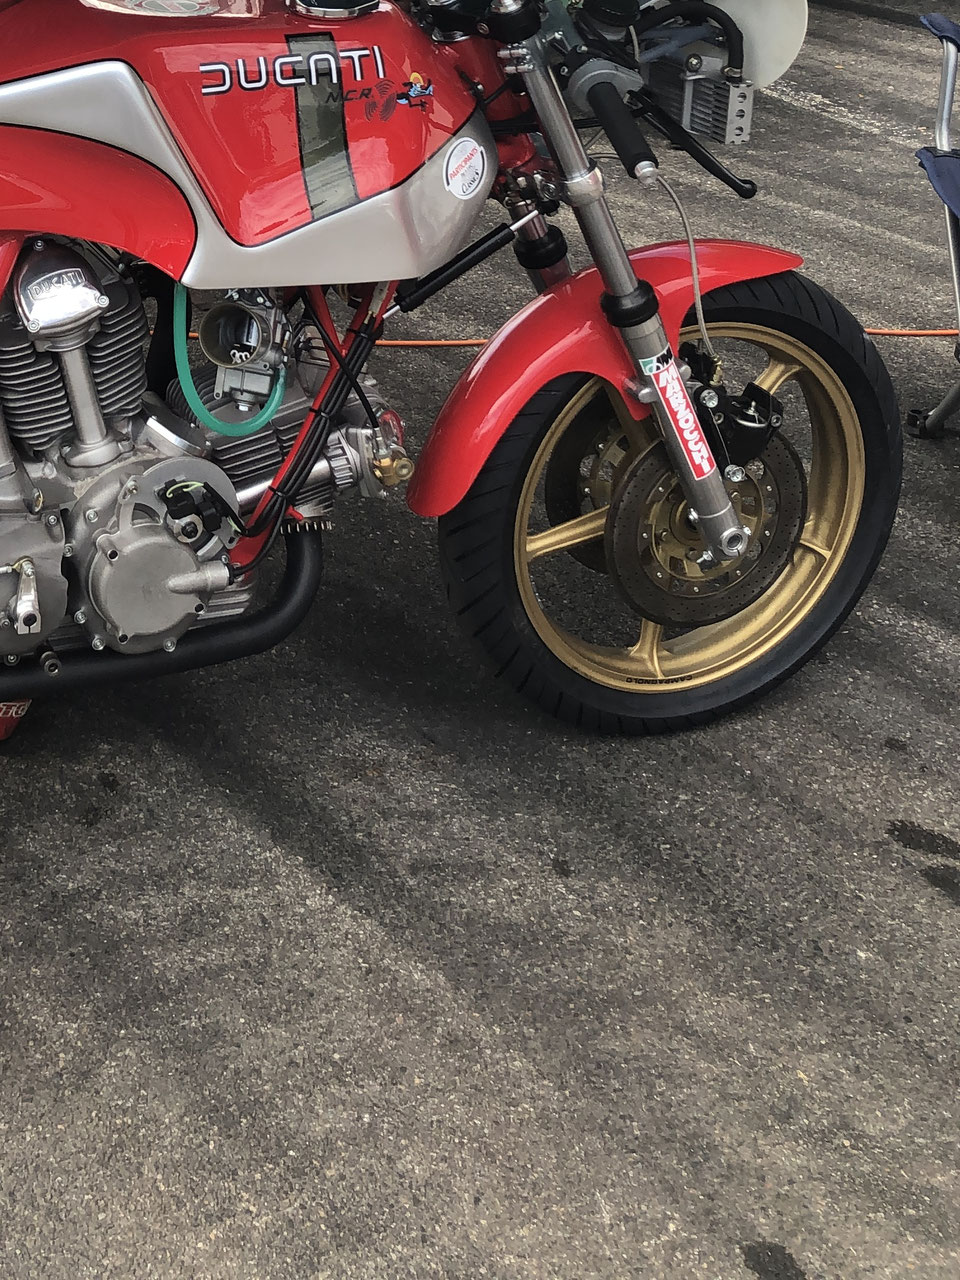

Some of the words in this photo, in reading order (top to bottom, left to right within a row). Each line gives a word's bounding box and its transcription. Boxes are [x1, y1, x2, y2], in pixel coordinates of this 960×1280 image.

[199, 45, 387, 96] DUCATI
[32, 271, 82, 295] DUCATI
[659, 364, 712, 475] MARZOCCHI
[626, 675, 693, 685] CAMPAGNOLO
